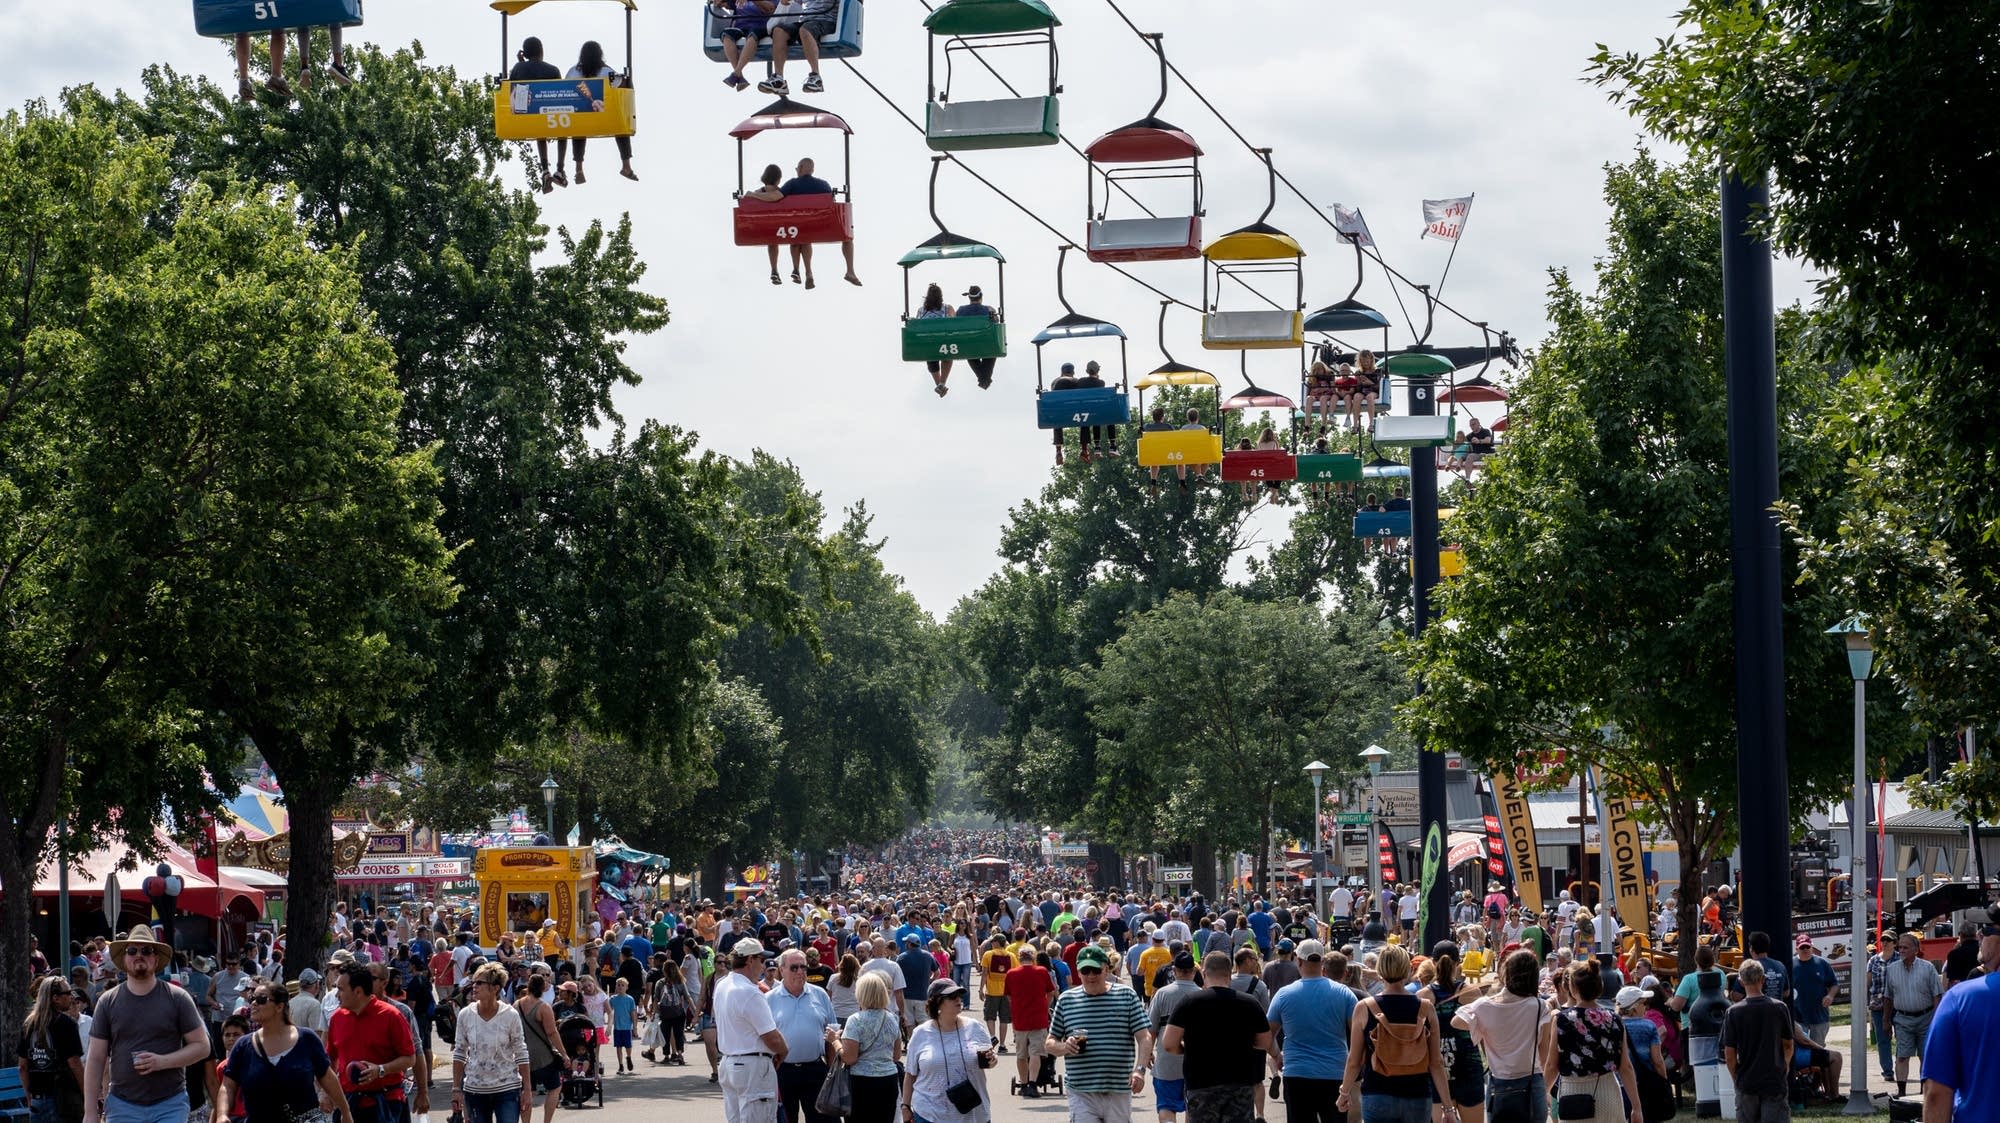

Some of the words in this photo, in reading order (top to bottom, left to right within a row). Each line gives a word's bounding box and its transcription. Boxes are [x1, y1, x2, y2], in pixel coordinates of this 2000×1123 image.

[254, 1, 279, 20] 51
[547, 113, 571, 128] 50
[776, 226, 798, 238] 49
[939, 343, 959, 354] 48
[1415, 388, 1426, 400] 6
[1072, 412, 1089, 422] 47
[1167, 452, 1183, 461] 46
[1250, 469, 1265, 477] 45
[1318, 471, 1332, 479] 44
[1338, 814, 1361, 823] WRIGHT
[1502, 779, 1534, 883] WELCOME
[1609, 800, 1639, 898] ELCOME
[504, 853, 531, 861] PRONTO
[533, 853, 550, 861] PUPS
[363, 865, 400, 875] CONES
[1797, 920, 1829, 931] REGISTER
[1829, 917, 1846, 927] HERE
